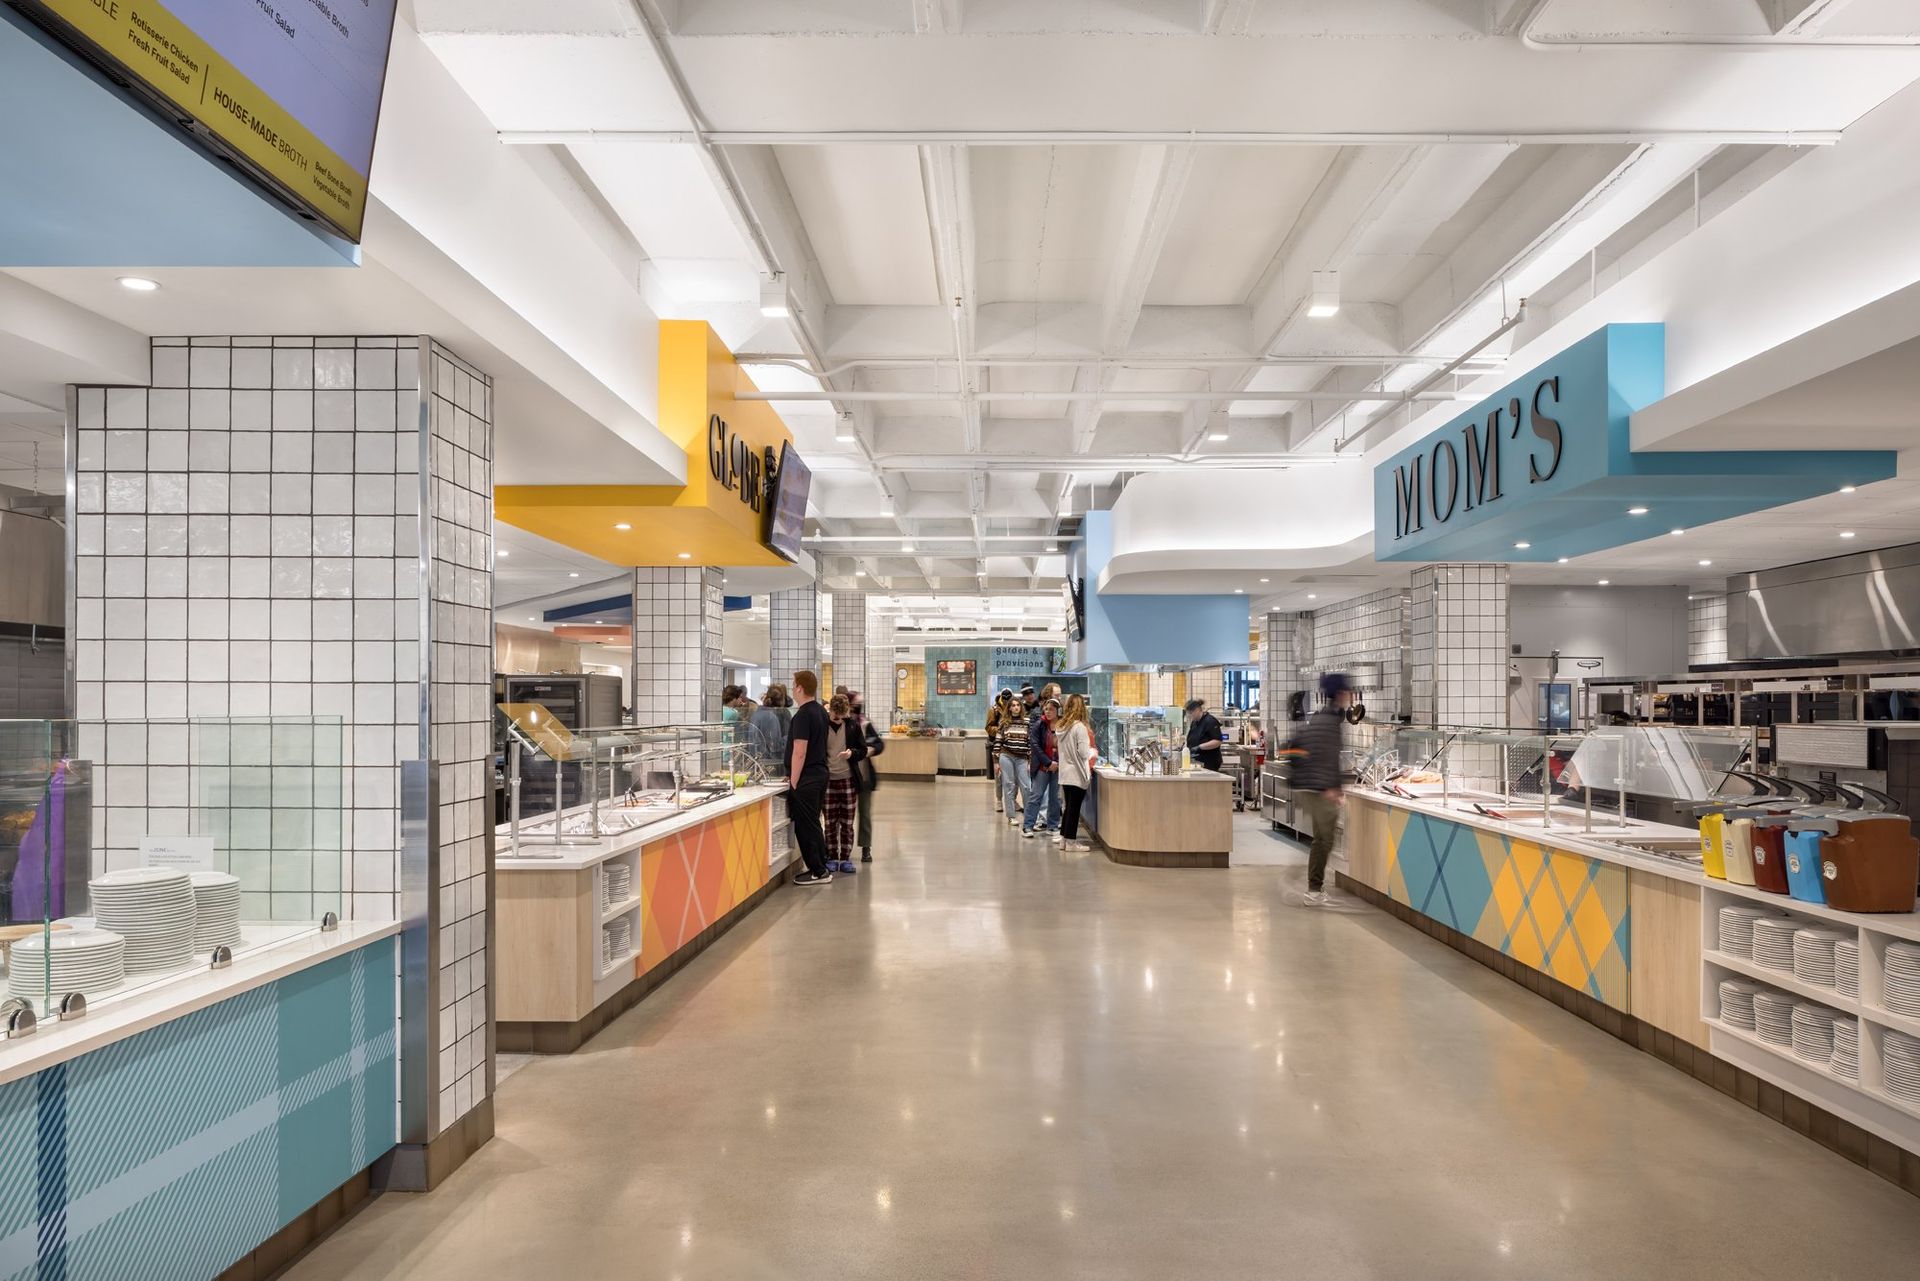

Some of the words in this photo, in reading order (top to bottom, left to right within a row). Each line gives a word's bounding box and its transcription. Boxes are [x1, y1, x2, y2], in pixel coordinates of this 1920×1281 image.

[131, 11, 169, 49] Rotisserie
[170, 44, 198, 72] Chicken
[275, 12, 296, 39] Salad
[331, 14, 349, 38] Broth
[128, 29, 151, 54] Fresh
[151, 47, 168, 69] Fruit
[170, 63, 190, 85] Salad
[213, 87, 278, 147] HOUSE-MADE
[278, 139, 308, 172] BROTH
[315, 161, 328, 176] Beef
[313, 175, 337, 200] Vegetable
[337, 194, 350, 210] Broth
[709, 413, 761, 513] GLOBE
[1393, 376, 1563, 541] MOM'S
[996, 647, 1028, 656] garden
[1032, 647, 1039, 655] &
[996, 659, 1044, 668] provisions
